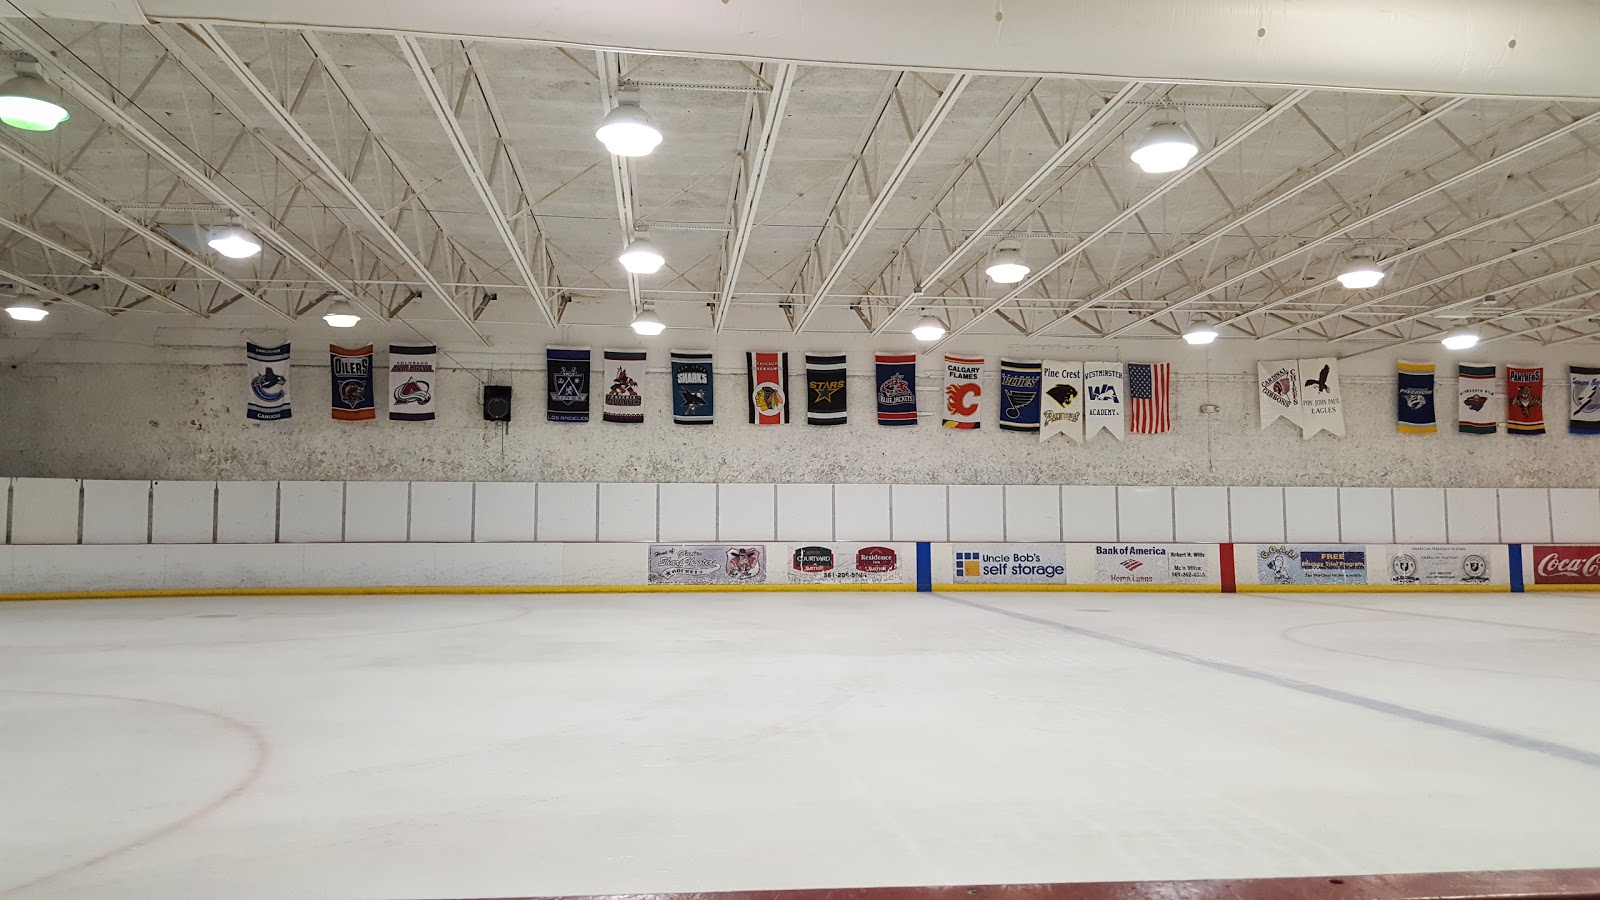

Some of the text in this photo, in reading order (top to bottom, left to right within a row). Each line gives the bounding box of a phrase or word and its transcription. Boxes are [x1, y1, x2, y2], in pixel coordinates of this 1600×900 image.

[334, 357, 368, 375] OILERS
[947, 364, 980, 373] CALGARY
[677, 372, 708, 384] SHARKS
[949, 371, 978, 380] FLAMES
[1044, 367, 1081, 379] Pine Crest
[1261, 367, 1289, 388] CARDINAL
[1510, 369, 1540, 383] PANTHERS
[809, 380, 845, 389] STARS
[1002, 376, 1039, 388] BLUES
[1289, 368, 1299, 406] CHIEFS
[1088, 384, 1120, 404] WA
[1262, 387, 1291, 408] GIBBONS
[1089, 408, 1116, 416] ACADEMY
[1311, 406, 1337, 414] EAGLES
[1096, 546, 1166, 555] Bank of America
[982, 553, 1041, 563] Uncle Bob's
[983, 563, 1065, 578] self storage
[1537, 553, 1600, 577] Coca-C
